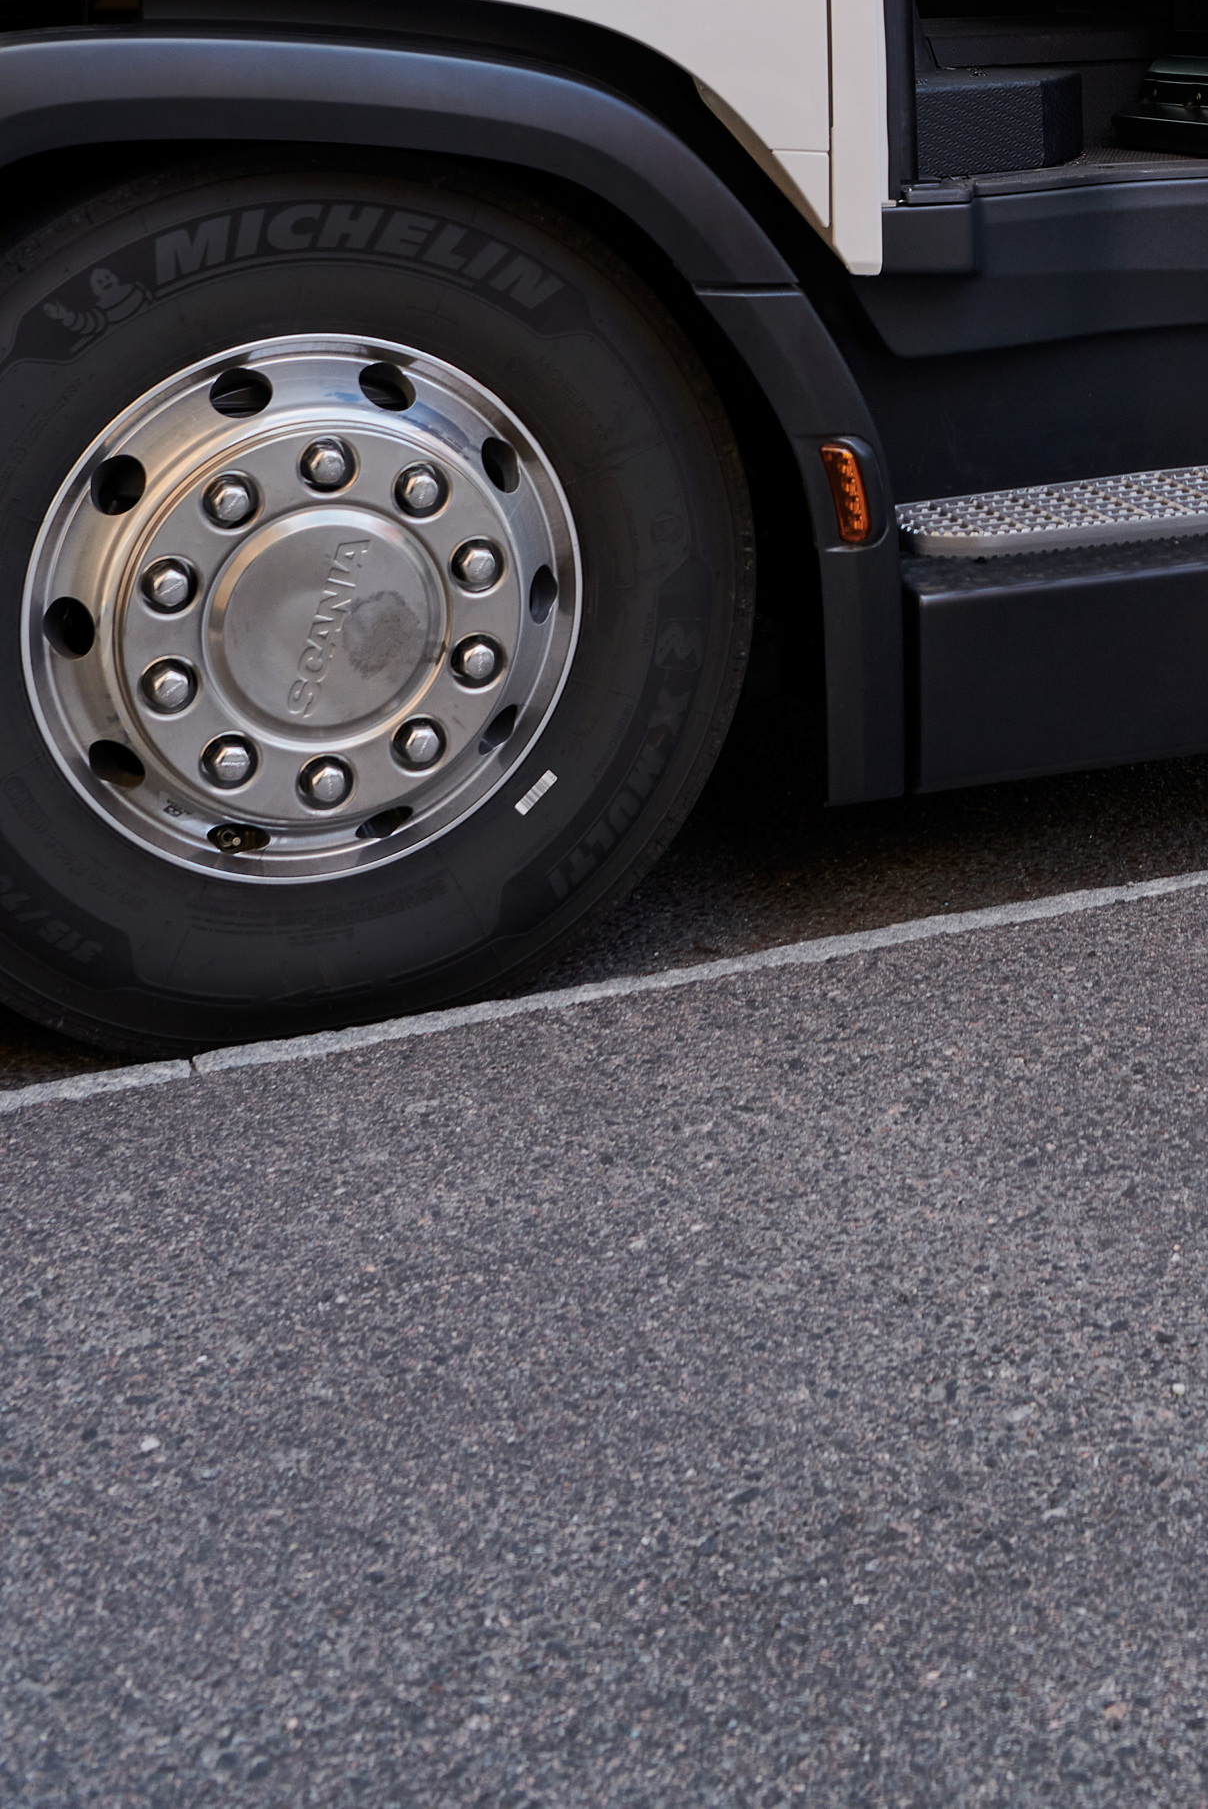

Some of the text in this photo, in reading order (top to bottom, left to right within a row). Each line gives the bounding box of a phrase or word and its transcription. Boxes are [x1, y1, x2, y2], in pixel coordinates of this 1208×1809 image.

[154, 204, 566, 310] MICHELIN
[287, 539, 371, 718] SCANIA
[547, 743, 665, 899] MULTI
